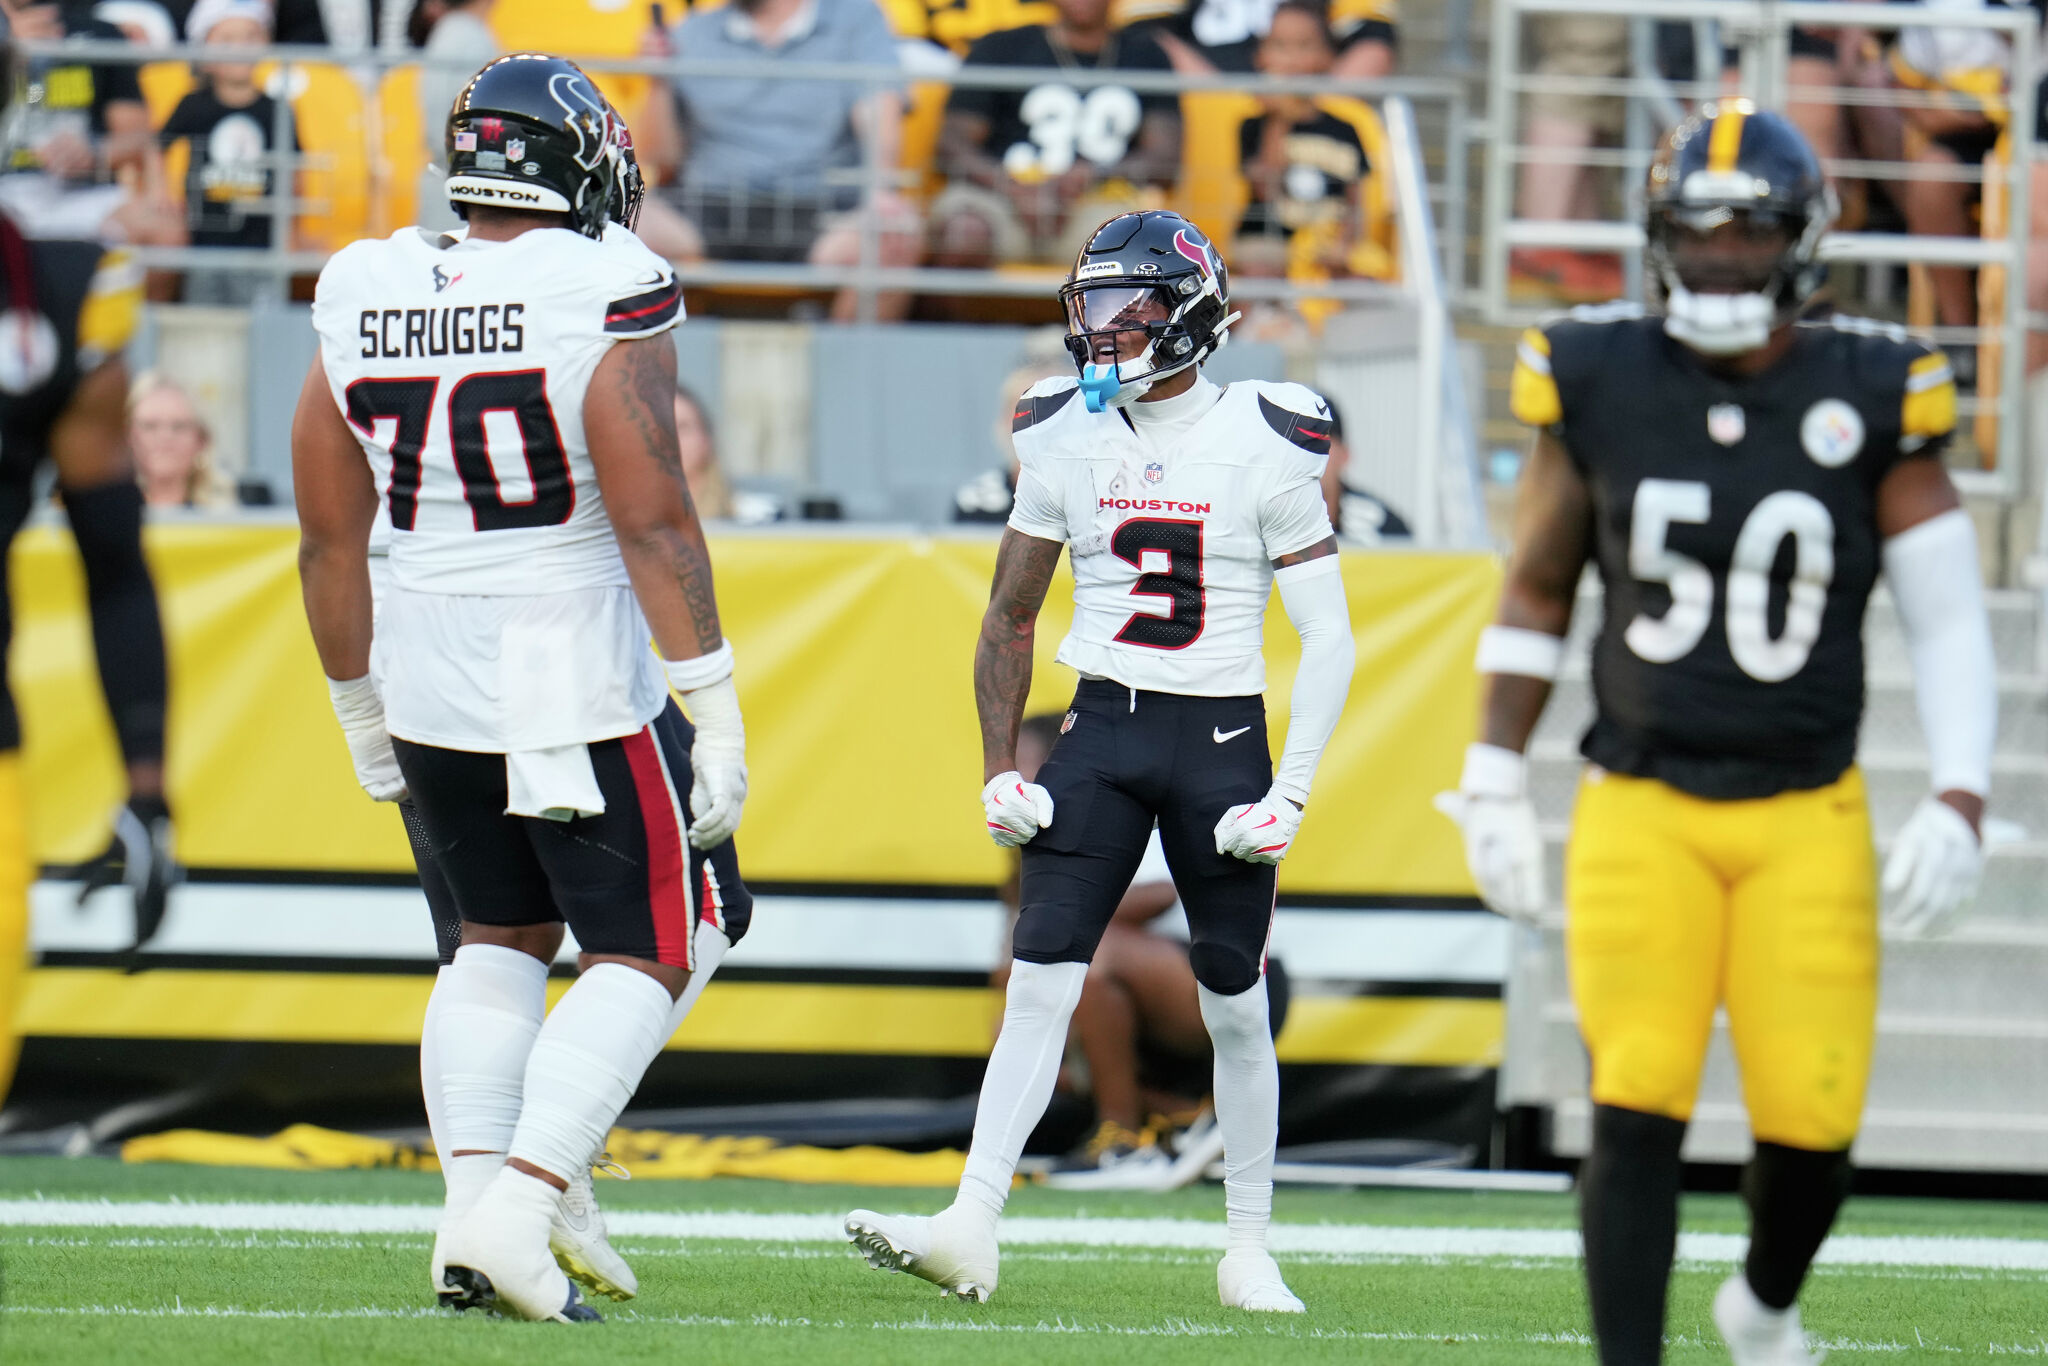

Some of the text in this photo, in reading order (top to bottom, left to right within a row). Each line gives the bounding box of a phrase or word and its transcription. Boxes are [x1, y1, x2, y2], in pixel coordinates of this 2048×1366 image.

[450, 185, 541, 203] HOUSTON
[1082, 264, 1116, 273] TEXANS
[360, 304, 525, 359] SCRUGGS
[345, 368, 576, 532] 70
[1146, 470, 1161, 481] NFL
[1099, 497, 1211, 514] HOUSTON
[1111, 516, 1206, 651] 3
[1625, 477, 1836, 684] 50
